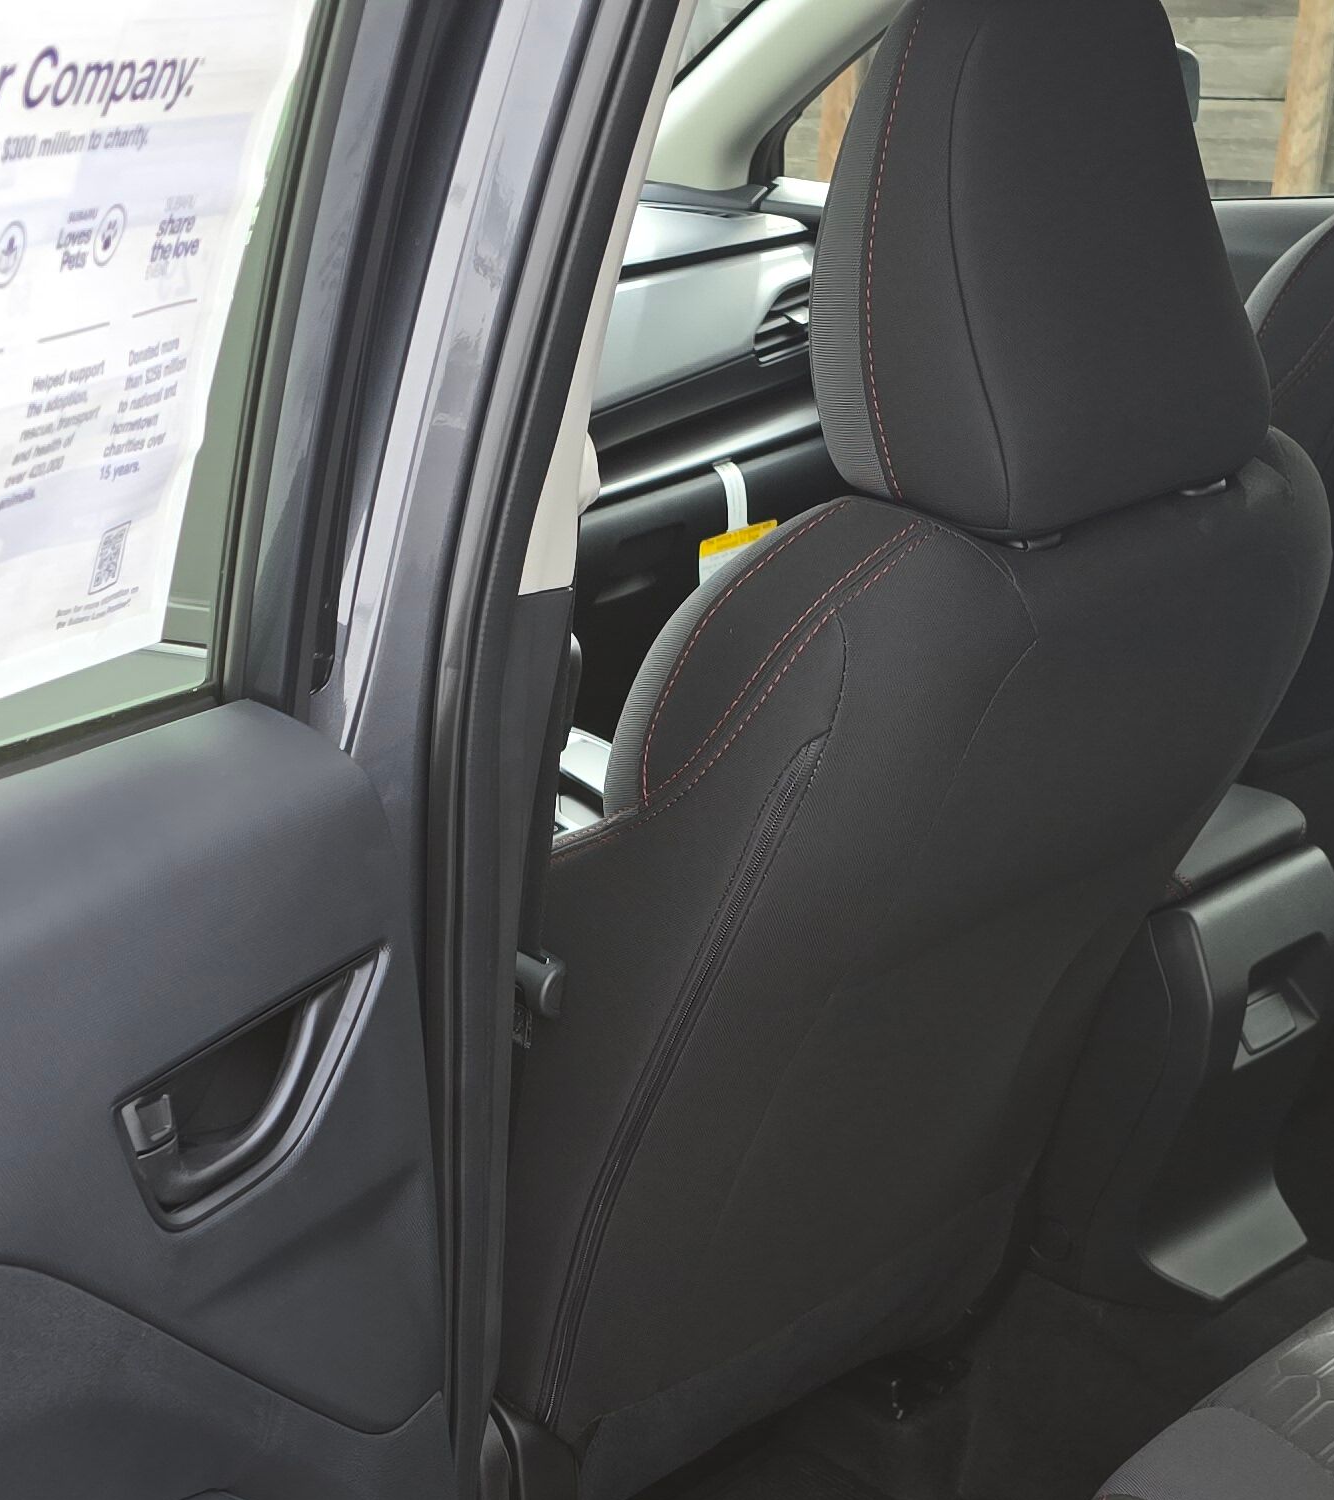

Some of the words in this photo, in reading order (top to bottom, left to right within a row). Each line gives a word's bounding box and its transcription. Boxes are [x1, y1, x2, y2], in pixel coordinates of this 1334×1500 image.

[1, 135, 37, 162] $300
[39, 131, 84, 157] million
[87, 130, 102, 151] to
[105, 126, 150, 151] charity.
[67, 207, 99, 224] SUBARU
[157, 214, 196, 237] share
[56, 226, 92, 250] Loves
[150, 239, 170, 262] the
[171, 234, 200, 260] love
[60, 250, 88, 272] Pets
